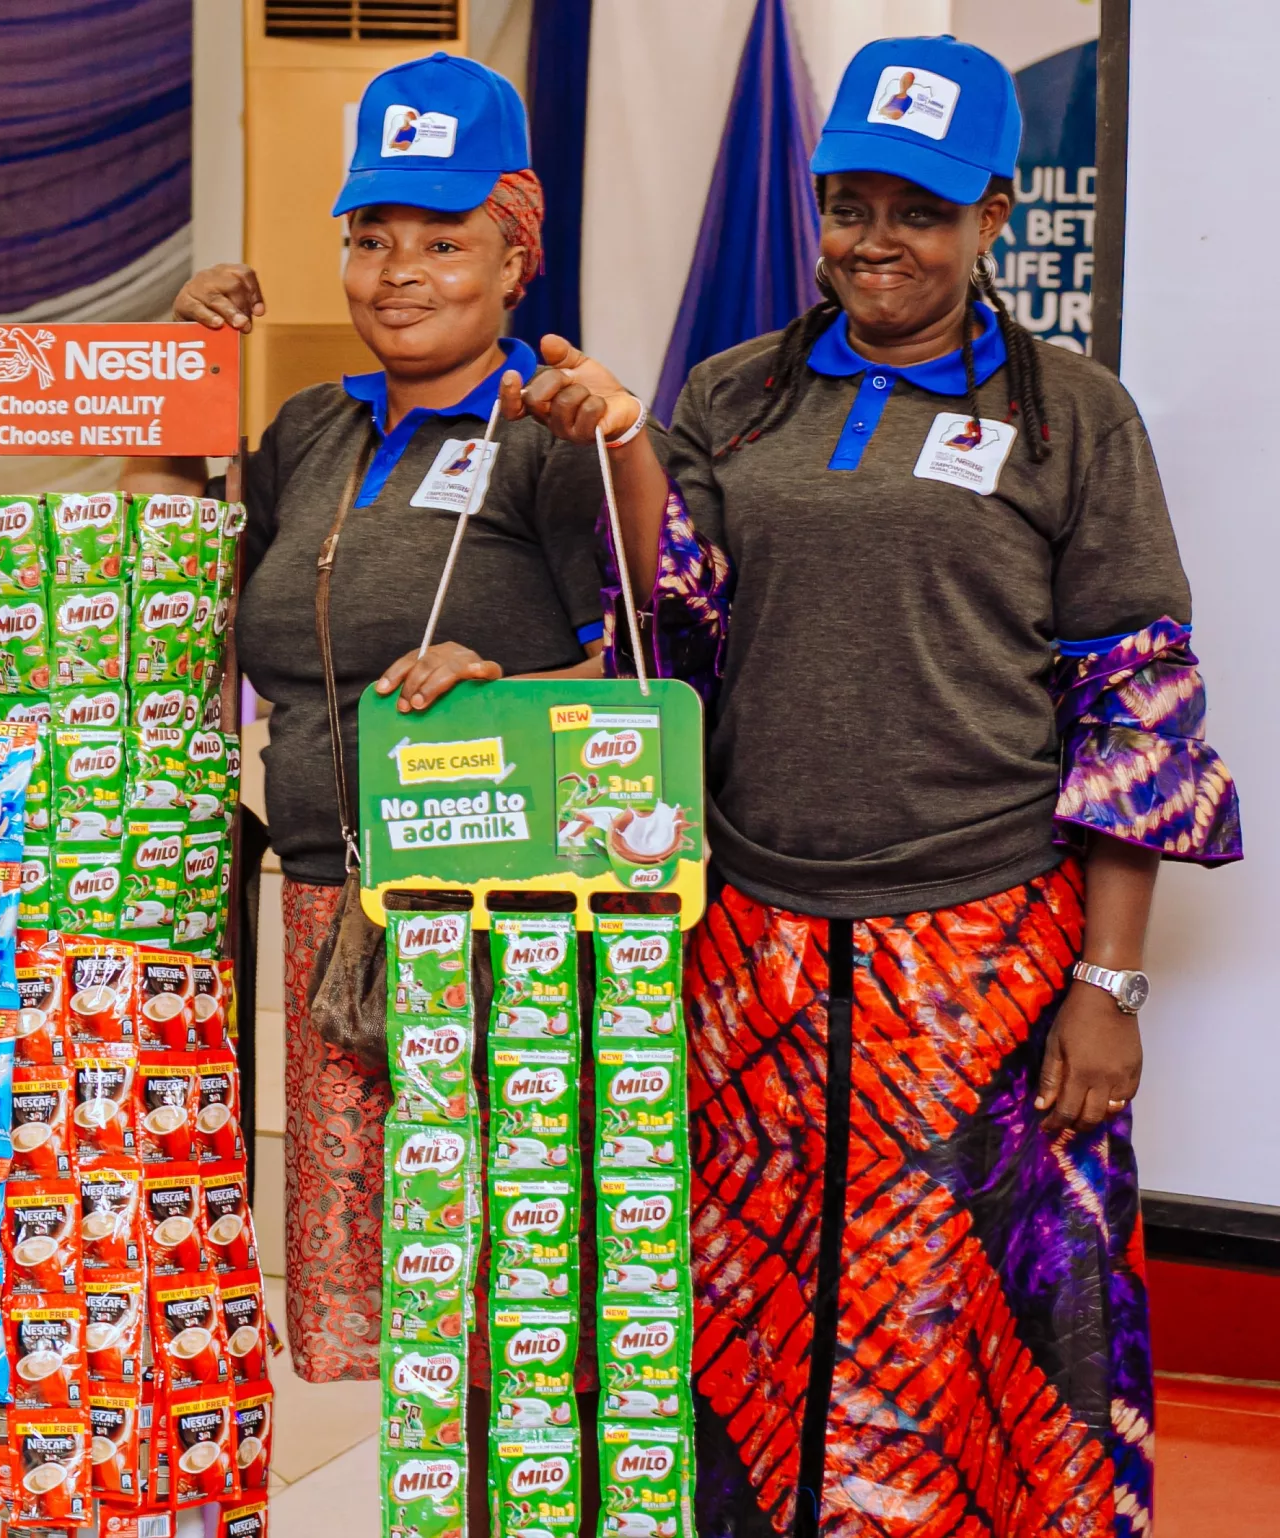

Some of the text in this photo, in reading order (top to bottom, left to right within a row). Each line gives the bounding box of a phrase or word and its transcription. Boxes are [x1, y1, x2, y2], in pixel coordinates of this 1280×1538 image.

[1014, 166, 1098, 203] UILD
[1027, 209, 1096, 246] BET
[65, 341, 205, 380] Nestlé
[75, 396, 164, 415] QUALITY
[81, 419, 161, 445] NESTLÉ
[63, 503, 111, 523] MILO
[149, 502, 191, 520] MILO
[66, 603, 114, 623] MILO
[148, 602, 188, 622] MILO
[70, 703, 115, 725] MILO
[143, 702, 180, 722] MILO
[557, 710, 589, 724] NEW
[193, 738, 220, 755] MILO
[590, 741, 636, 758] MILO
[74, 756, 116, 772] MILO
[408, 754, 495, 772] SAVE CASH!
[608, 776, 653, 793] 3 in 1
[381, 792, 525, 820] No need to
[402, 815, 515, 843] add milk
[140, 847, 178, 861] MILO
[187, 856, 214, 875] MILO
[74, 878, 114, 895] MILO
[634, 873, 658, 882] MILO
[405, 926, 458, 948] MILO
[511, 947, 559, 964] MILO
[616, 946, 662, 963] MILO
[636, 981, 674, 995] 3 in 1
[406, 1037, 460, 1057] MILO
[601, 1053, 622, 1061] NEW!
[616, 1078, 663, 1095] MILO
[406, 1146, 459, 1165] MILO
[45, 1196, 69, 1204] FREE
[512, 1209, 558, 1226] MILO
[620, 1207, 666, 1223] MILO
[402, 1256, 454, 1274] MILO
[514, 1338, 560, 1356] MILO
[621, 1332, 668, 1349] MILO
[54, 1425, 79, 1433] FREE
[427, 1464, 452, 1472] Nestlé
[621, 1457, 667, 1472] MILO
[399, 1472, 453, 1492] MILO
[517, 1468, 564, 1486] MILO
